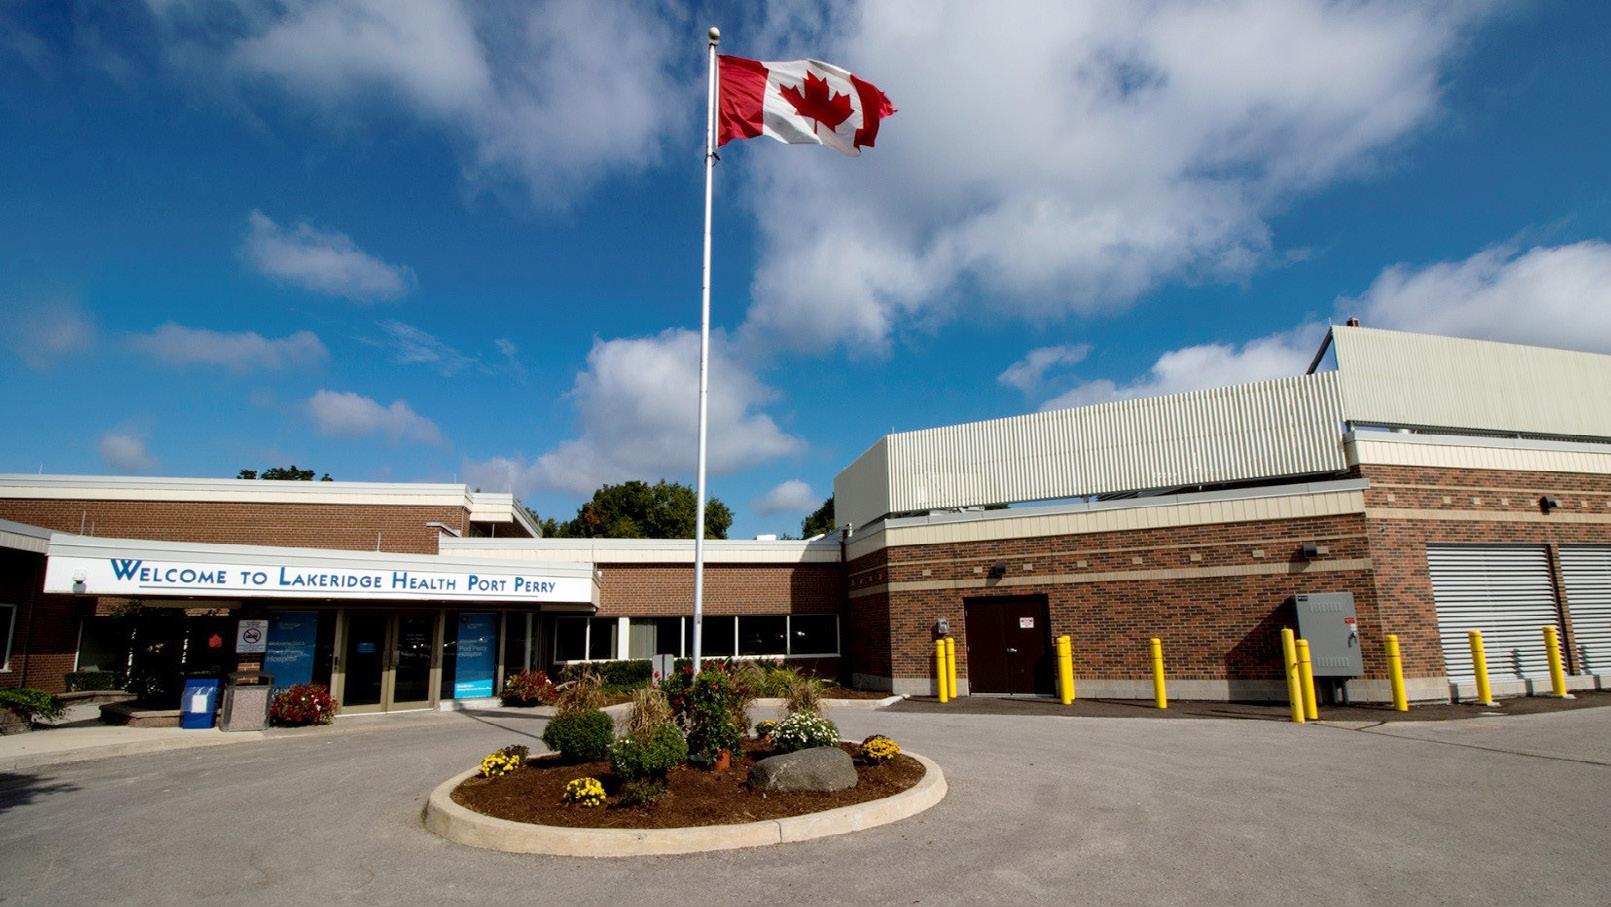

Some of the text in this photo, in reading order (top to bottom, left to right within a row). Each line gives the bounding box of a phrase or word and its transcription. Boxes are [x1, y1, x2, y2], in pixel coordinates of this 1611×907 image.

[111, 558, 556, 593] WELCOME TO LAKERIDGE HEALTH PORT PERRY
